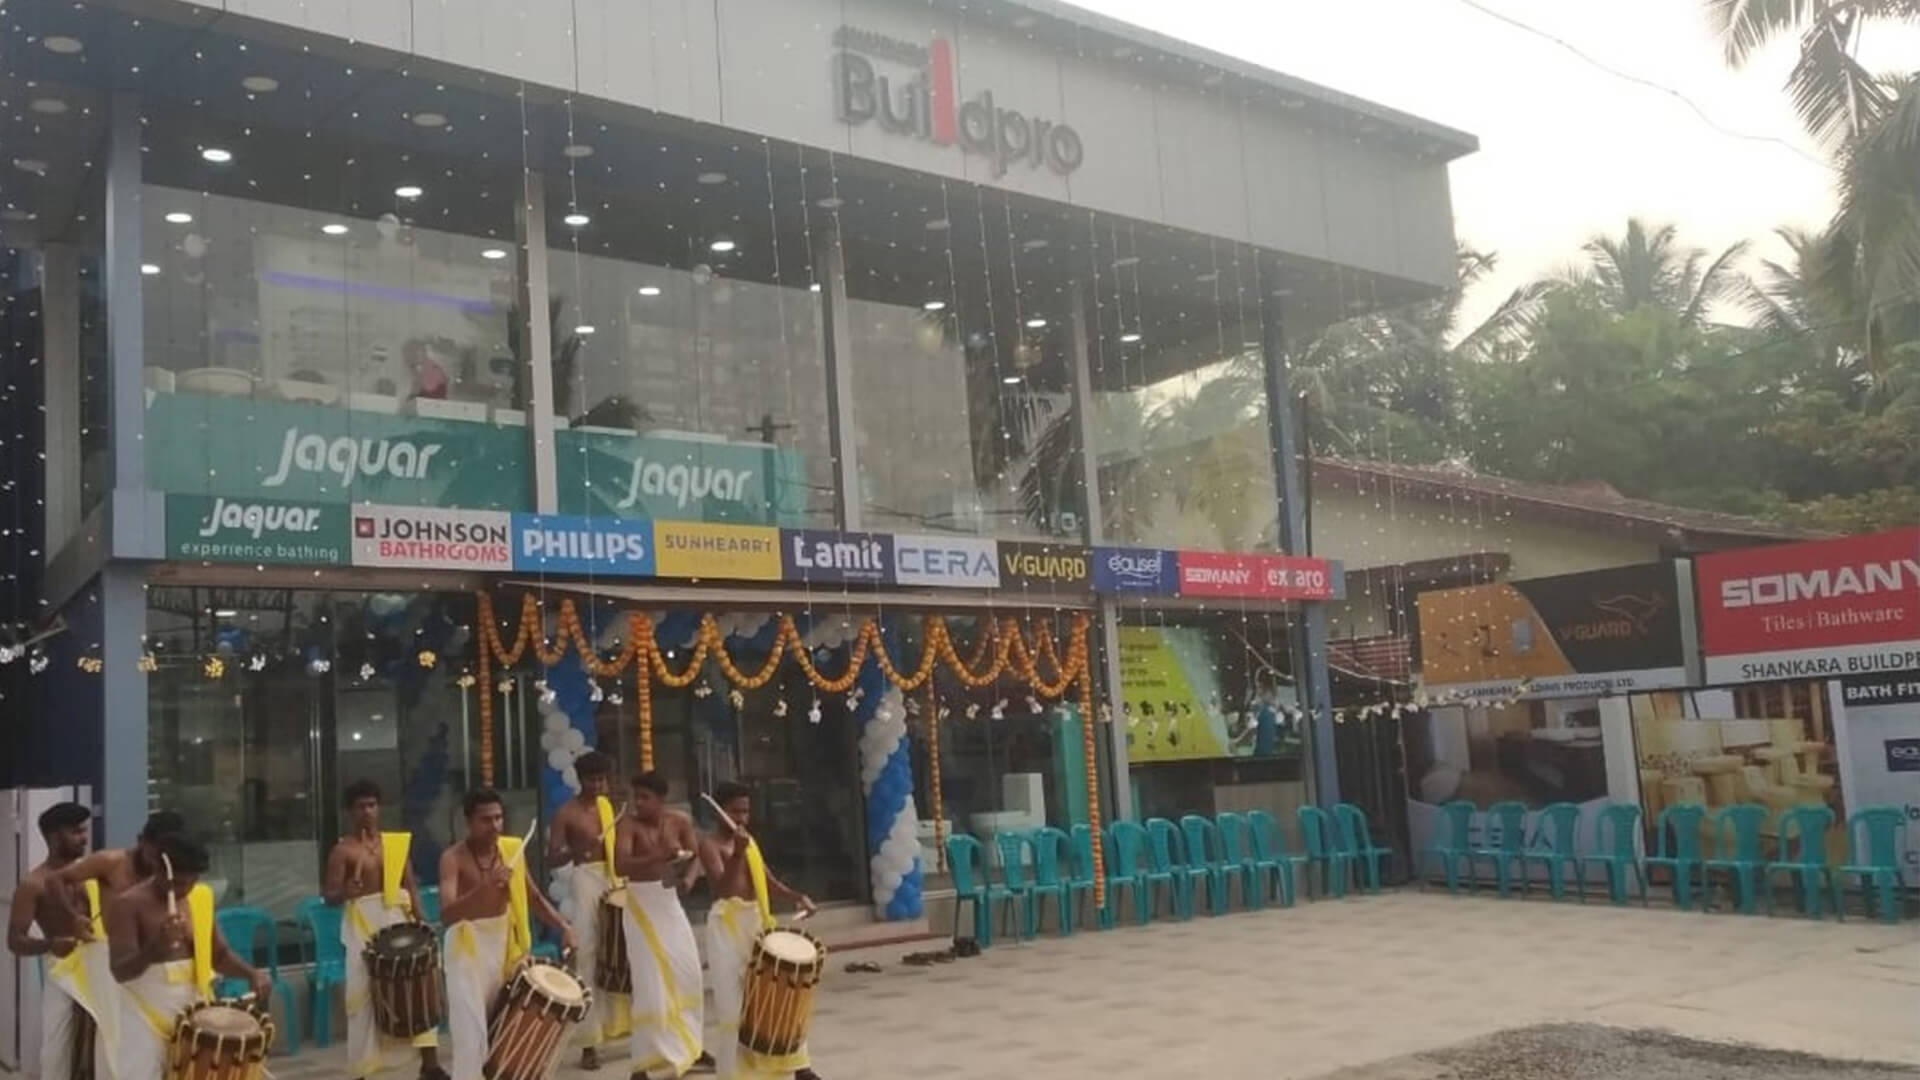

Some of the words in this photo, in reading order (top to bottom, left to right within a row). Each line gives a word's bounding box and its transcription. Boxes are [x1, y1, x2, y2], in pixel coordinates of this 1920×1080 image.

[261, 427, 442, 487] Jaquar
[615, 456, 752, 508] Jaquar
[380, 518, 507, 544] JOHNSON
[181, 542, 273, 557] experience
[277, 542, 339, 562] bathing
[379, 541, 508, 563] BATHROOMS
[522, 529, 645, 561] PHILIPS
[793, 535, 883, 570] Lamit
[898, 548, 997, 578] CERA
[1762, 614, 1804, 632] Tiles
[1816, 608, 1904, 627] Bathware
[1741, 657, 1842, 679] SHANKARA
[1847, 684, 1892, 700] BATH
